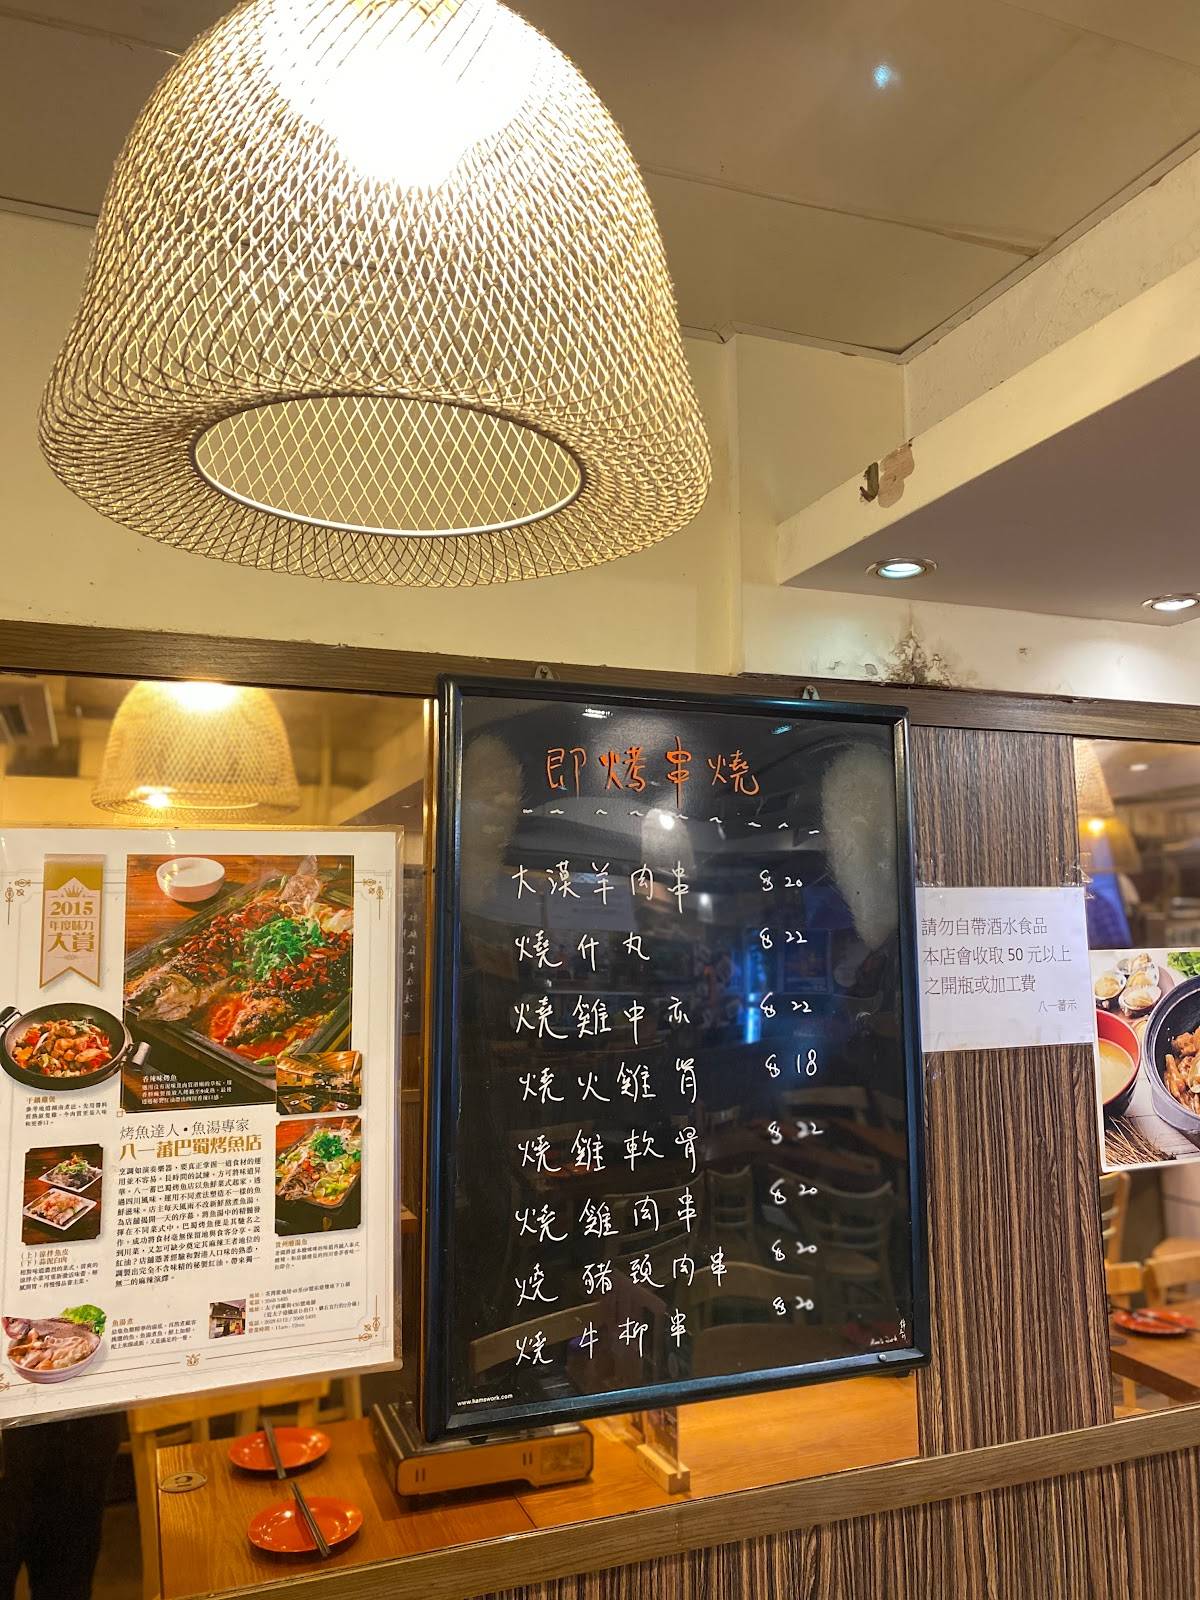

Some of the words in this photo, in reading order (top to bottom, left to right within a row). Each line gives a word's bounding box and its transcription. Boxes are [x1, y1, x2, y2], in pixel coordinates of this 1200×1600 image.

[545, 736, 761, 808] 即烤串燒
[50, 901, 93, 916] 2015
[921, 916, 1048, 936] 請勿自帶酒水食品
[48, 932, 95, 953] 大賞
[923, 946, 1004, 966] 本店會收取
[1007, 947, 1024, 962] 50
[1027, 945, 1072, 963] 元以上
[924, 973, 1036, 995] 之開瓶或加工費
[515, 1187, 697, 1242] 燒雞肉串
